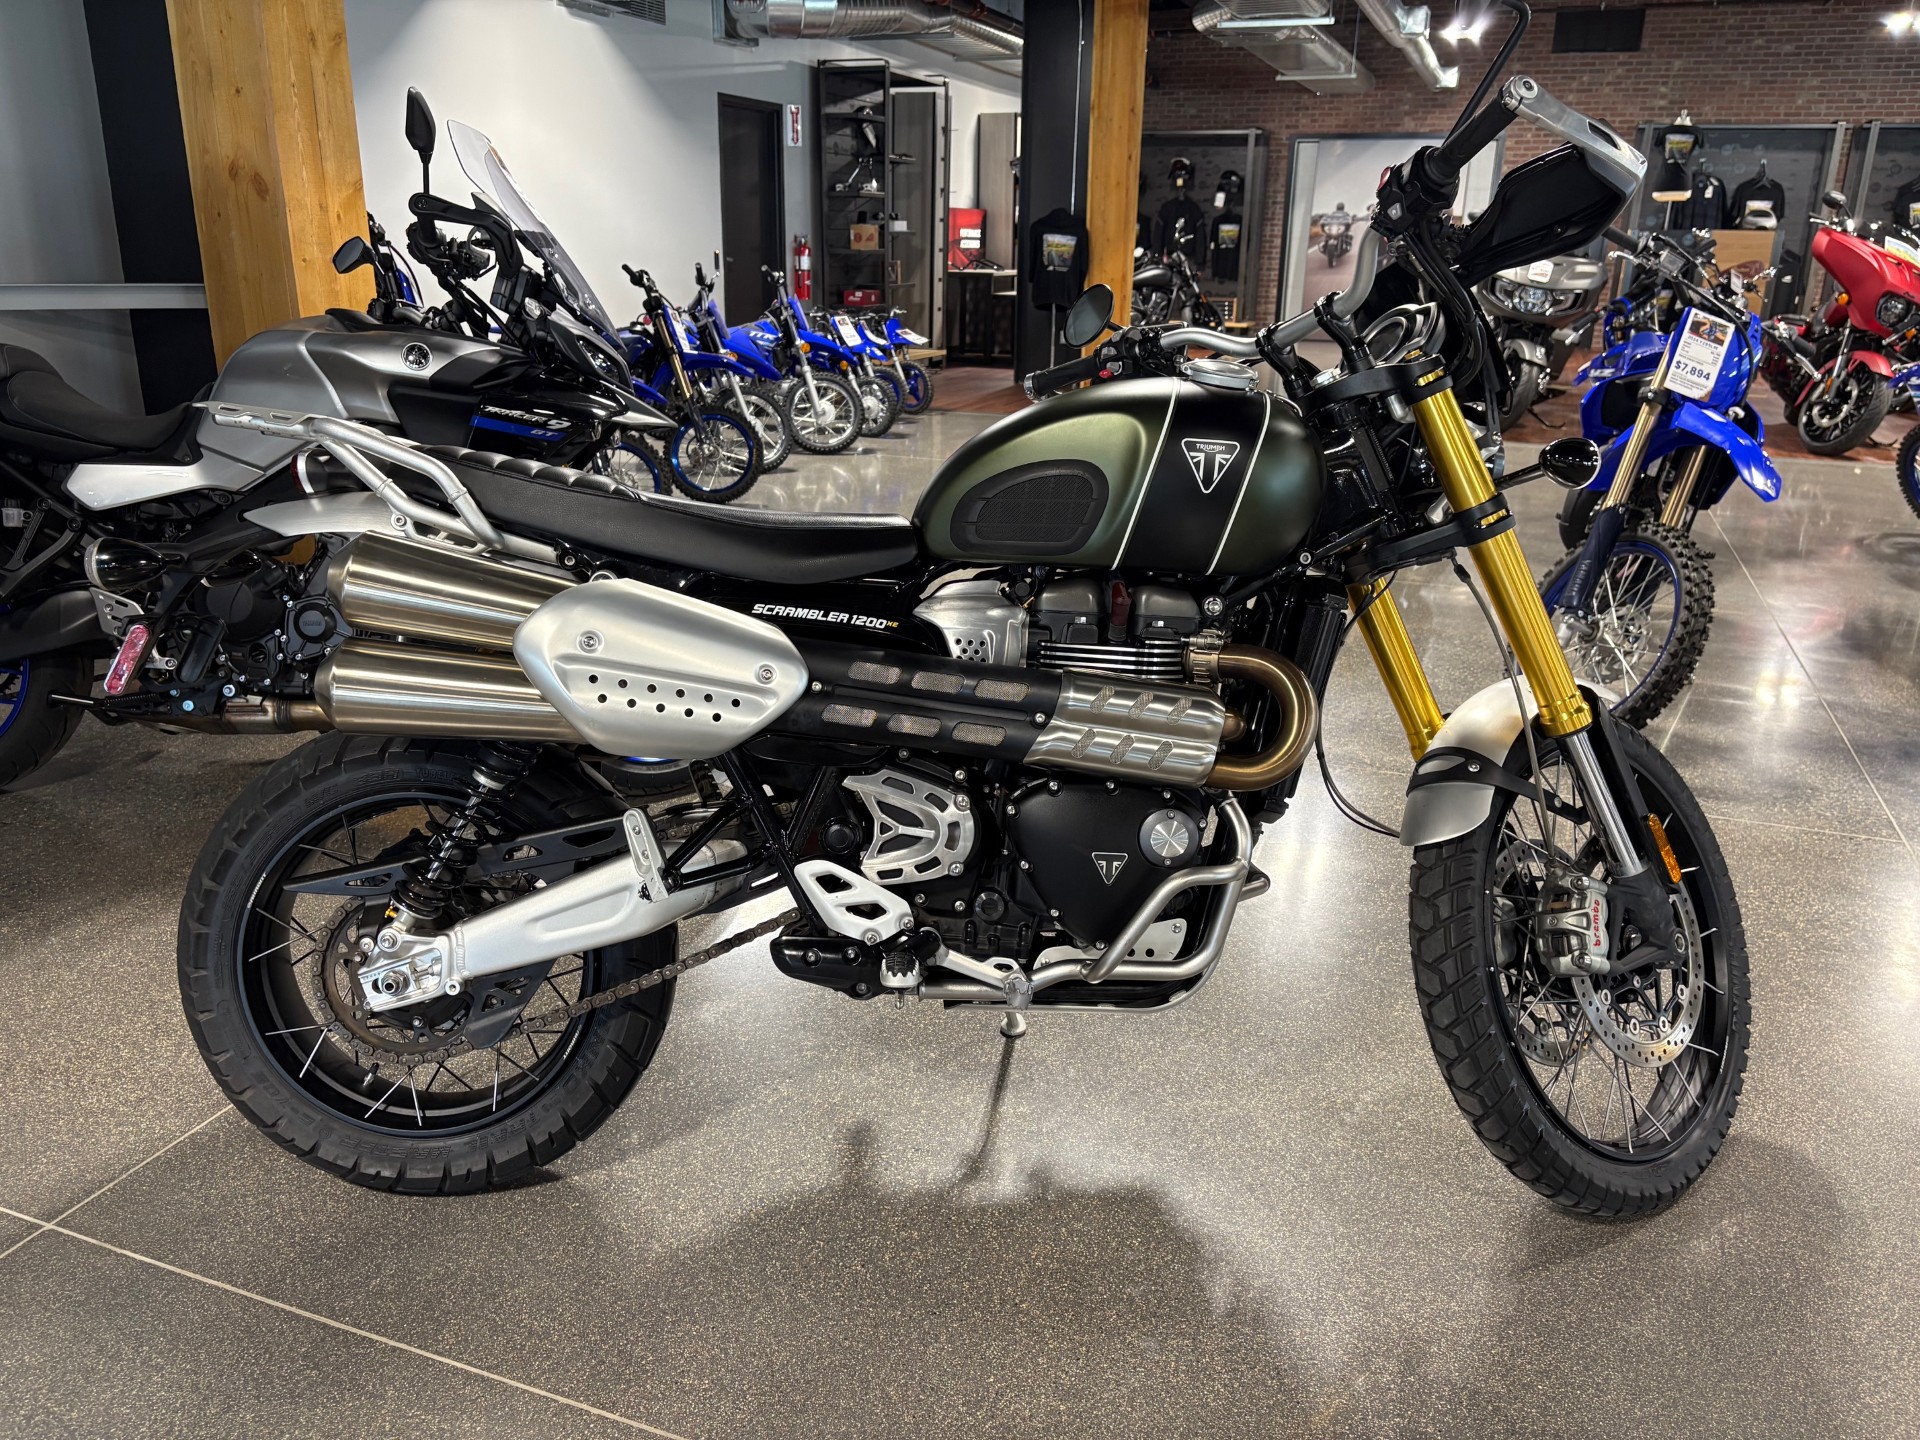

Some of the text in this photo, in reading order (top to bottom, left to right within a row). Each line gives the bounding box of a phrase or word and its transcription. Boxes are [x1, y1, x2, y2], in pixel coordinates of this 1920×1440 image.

[1674, 360, 1711, 381] $7,894
[546, 420, 571, 430] 9
[530, 429, 559, 437] GT
[1196, 443, 1226, 453] TRIUMPH
[751, 603, 850, 624] SCRAMBLER
[849, 614, 888, 629] 1200
[1590, 899, 1602, 948] brembo
